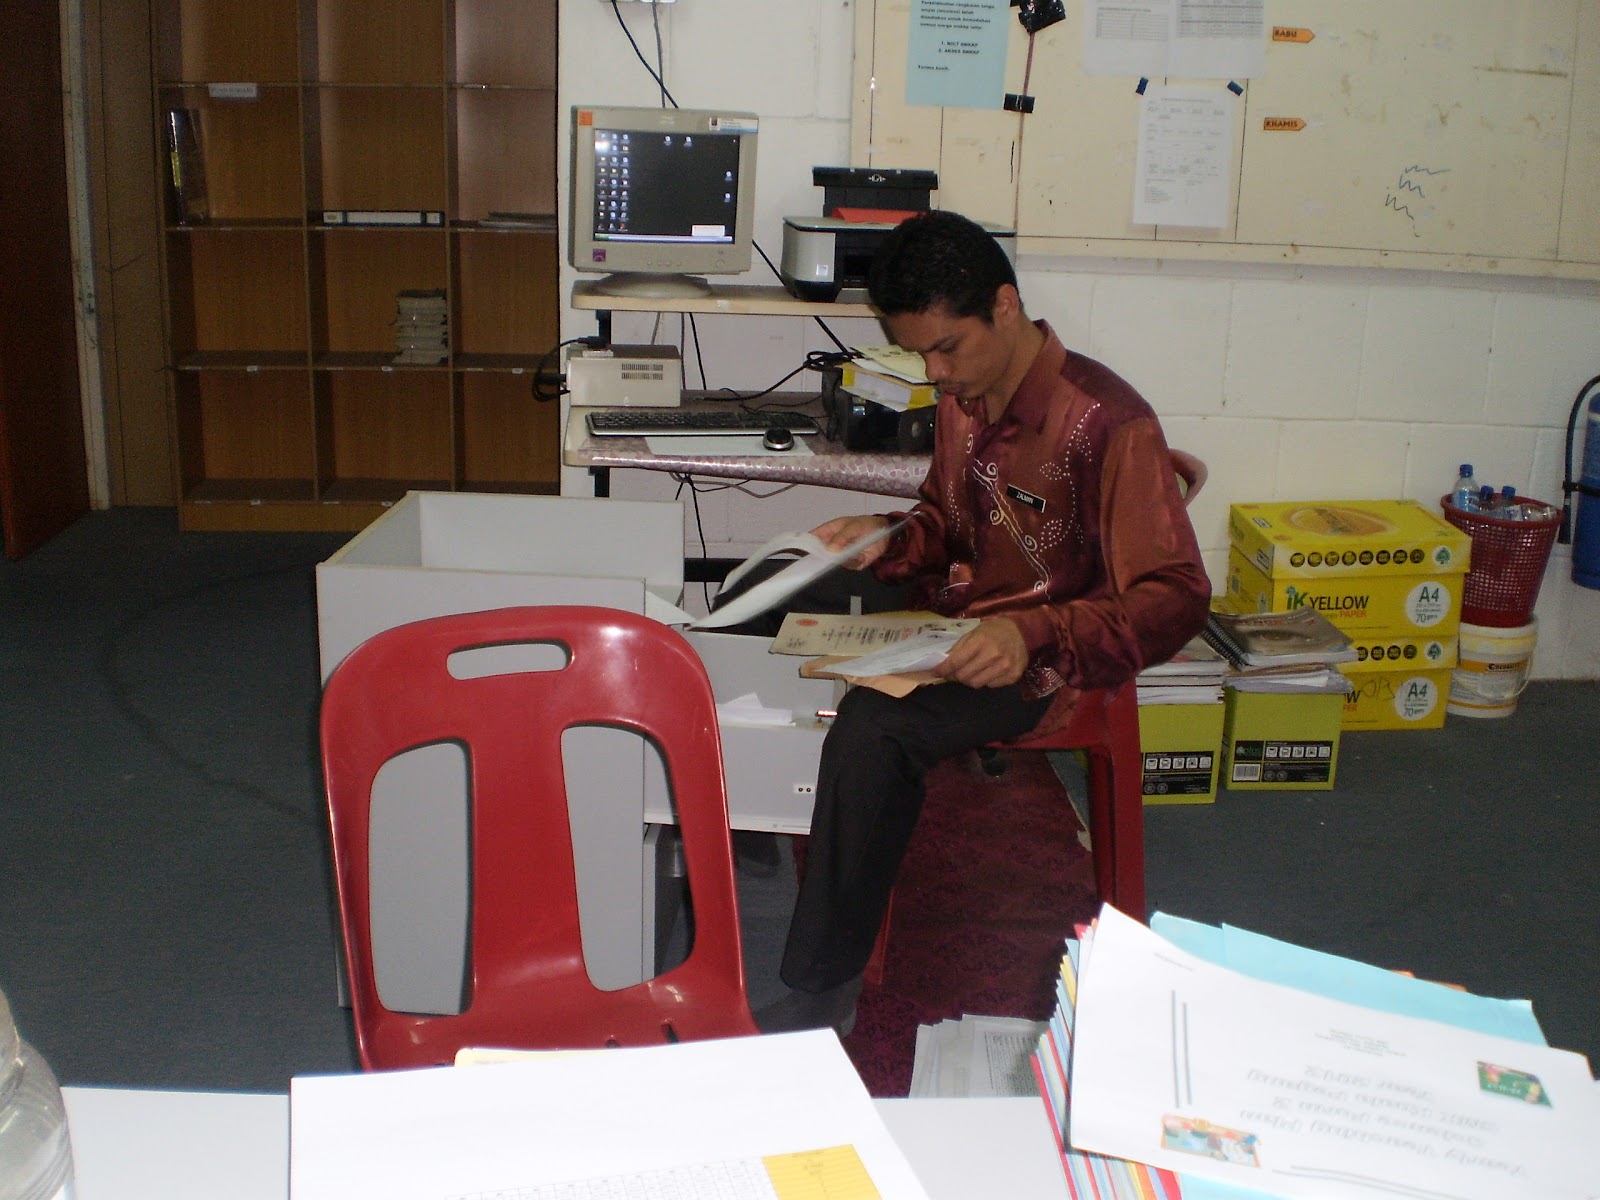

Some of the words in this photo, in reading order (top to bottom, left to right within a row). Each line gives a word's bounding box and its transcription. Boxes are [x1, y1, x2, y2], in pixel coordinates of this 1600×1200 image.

[1274, 29, 1298, 38] RABU
[1265, 120, 1298, 129] KHAMIS
[1418, 586, 1440, 603] A4
[1309, 596, 1370, 611] YELLOW
[1407, 682, 1429, 698] A4
